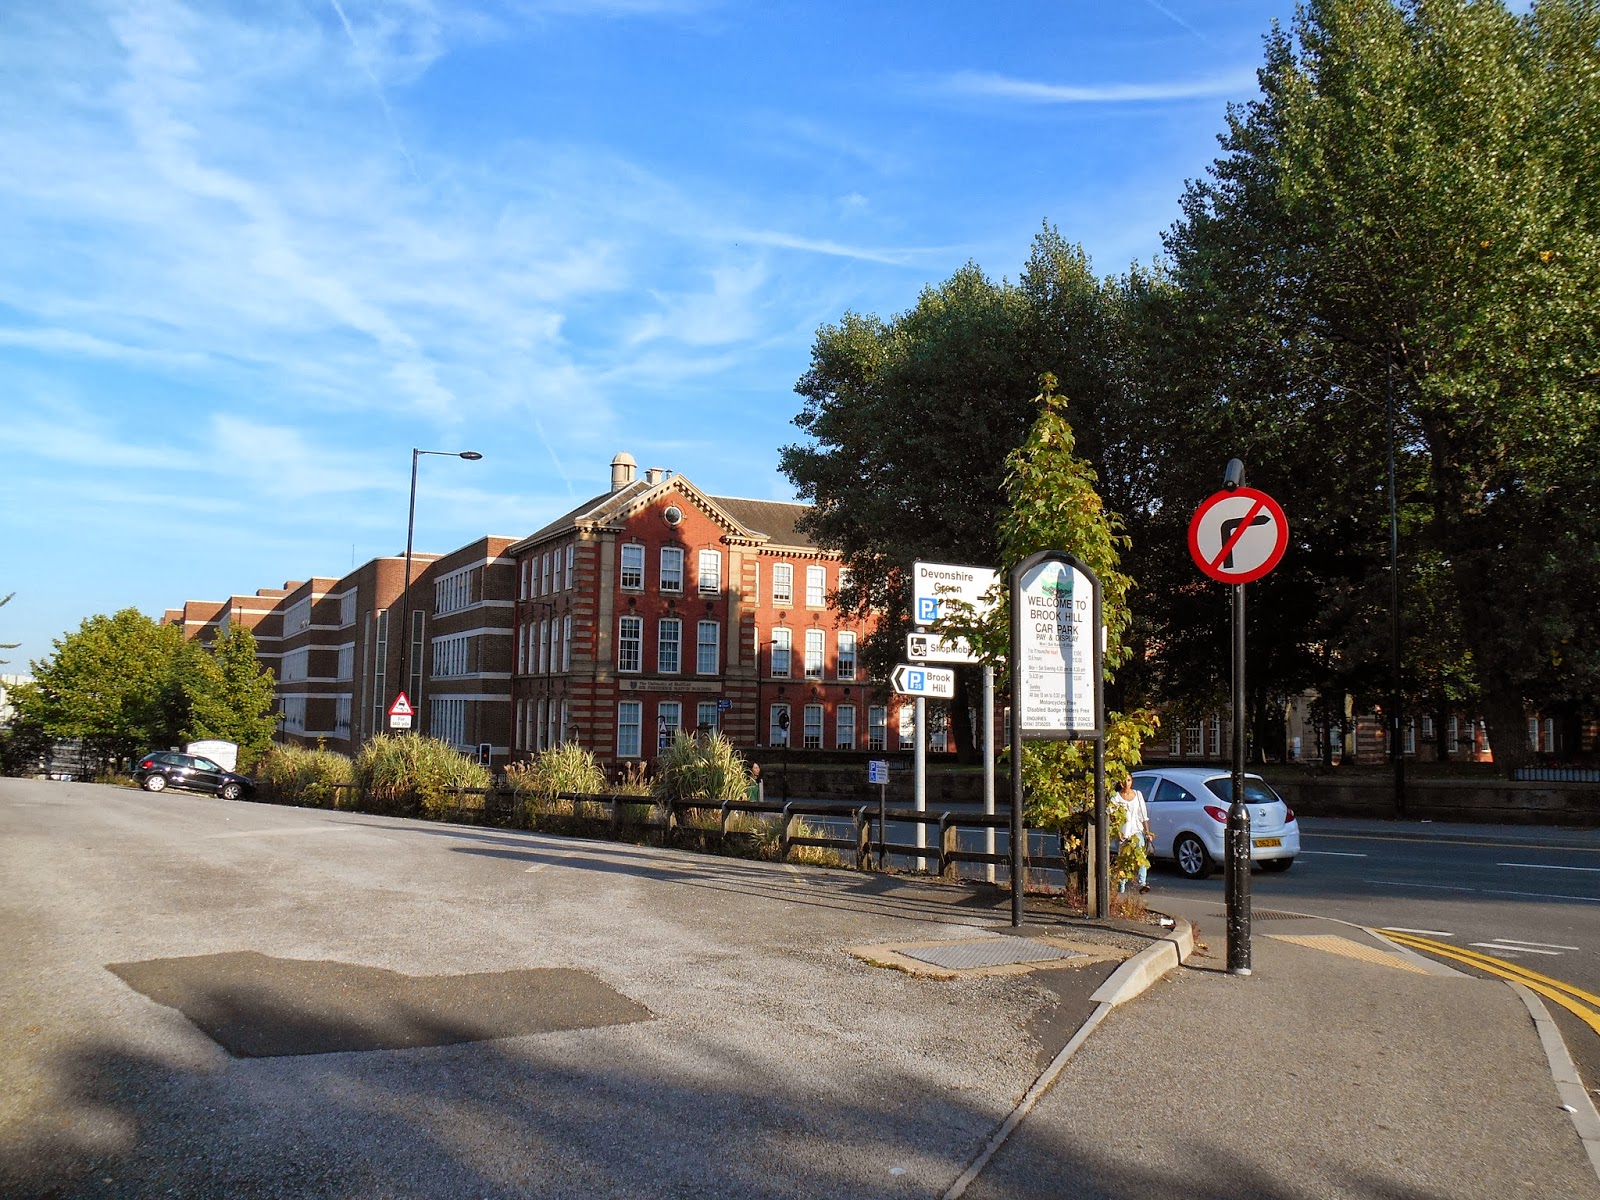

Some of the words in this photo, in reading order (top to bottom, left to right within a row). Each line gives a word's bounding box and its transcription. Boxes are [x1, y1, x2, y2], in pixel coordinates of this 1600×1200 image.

[920, 568, 974, 581] Devonshire
[934, 582, 962, 593] Green
[1028, 596, 1072, 609] WELCOME
[1076, 600, 1086, 610] TO
[1030, 609, 1061, 621] BROOK
[1065, 612, 1083, 623] HILL
[1035, 623, 1053, 633] CAR
[1057, 625, 1079, 635] PARK
[1036, 633, 1046, 641] PAY
[1055, 634, 1079, 642] DISPLAY
[926, 672, 951, 682] Brook
[932, 684, 947, 693] Hill
